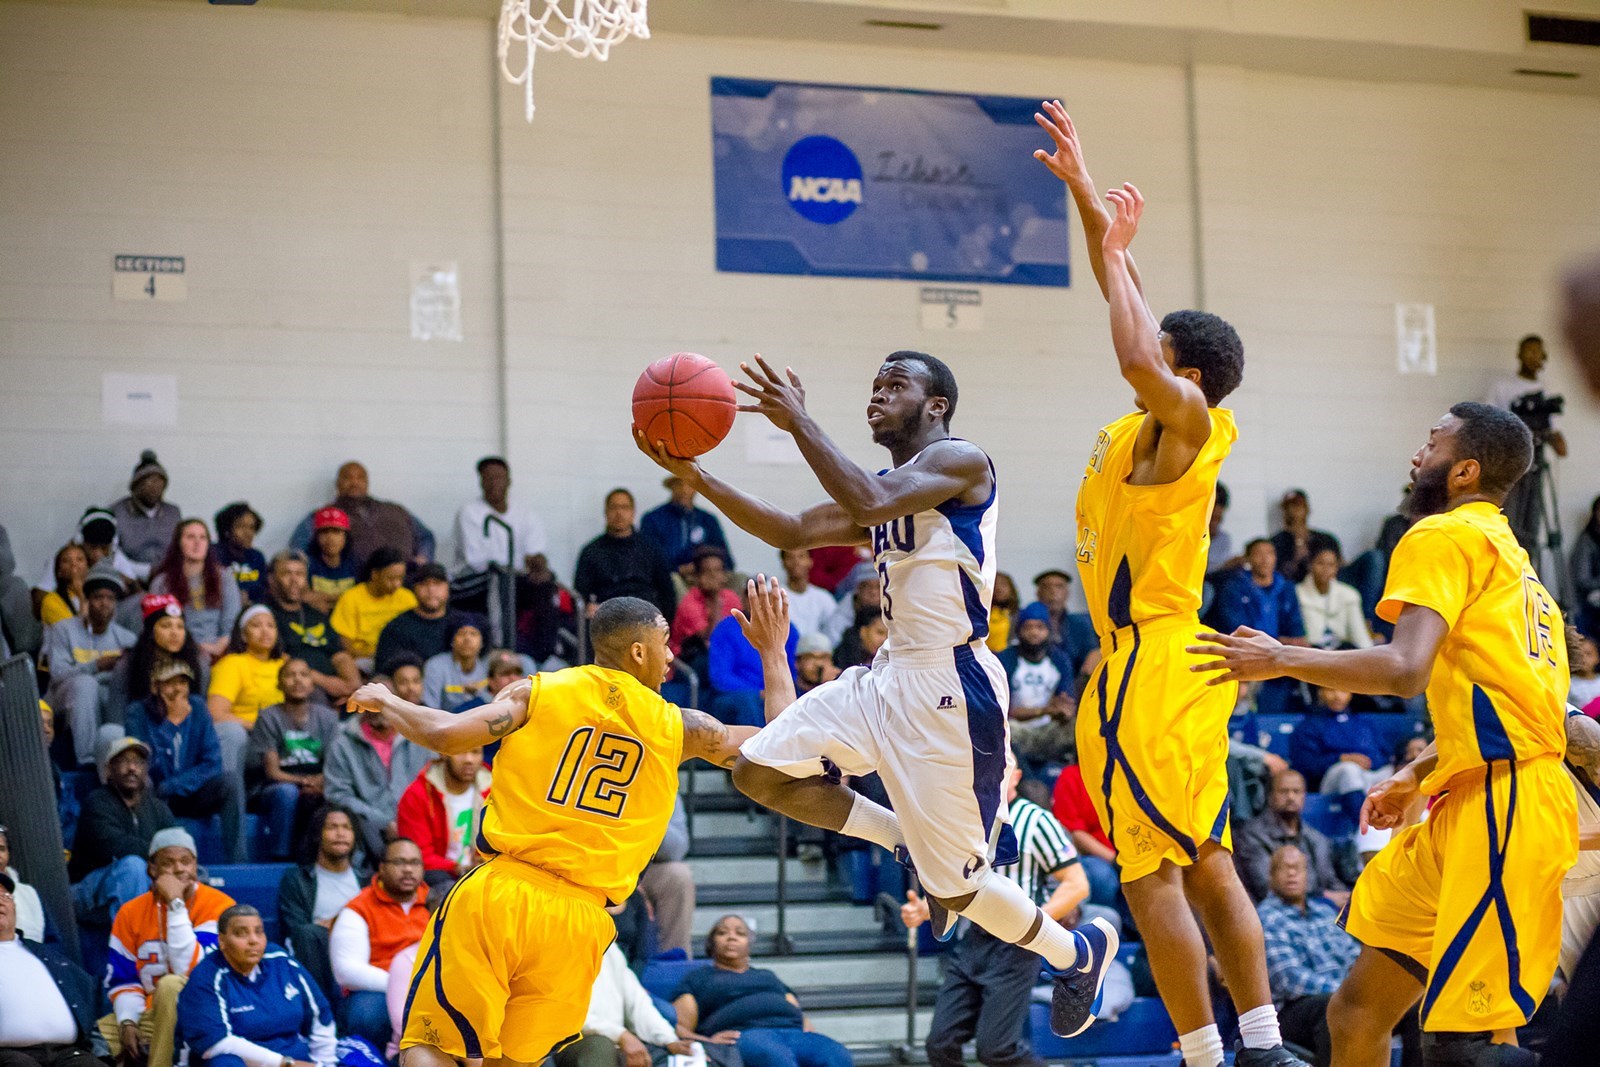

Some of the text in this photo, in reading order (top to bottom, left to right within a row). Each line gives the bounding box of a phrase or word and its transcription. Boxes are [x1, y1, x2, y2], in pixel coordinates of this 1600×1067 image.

[789, 175, 862, 204] NCAA
[144, 275, 155, 299] 4
[546, 726, 645, 818] 12
